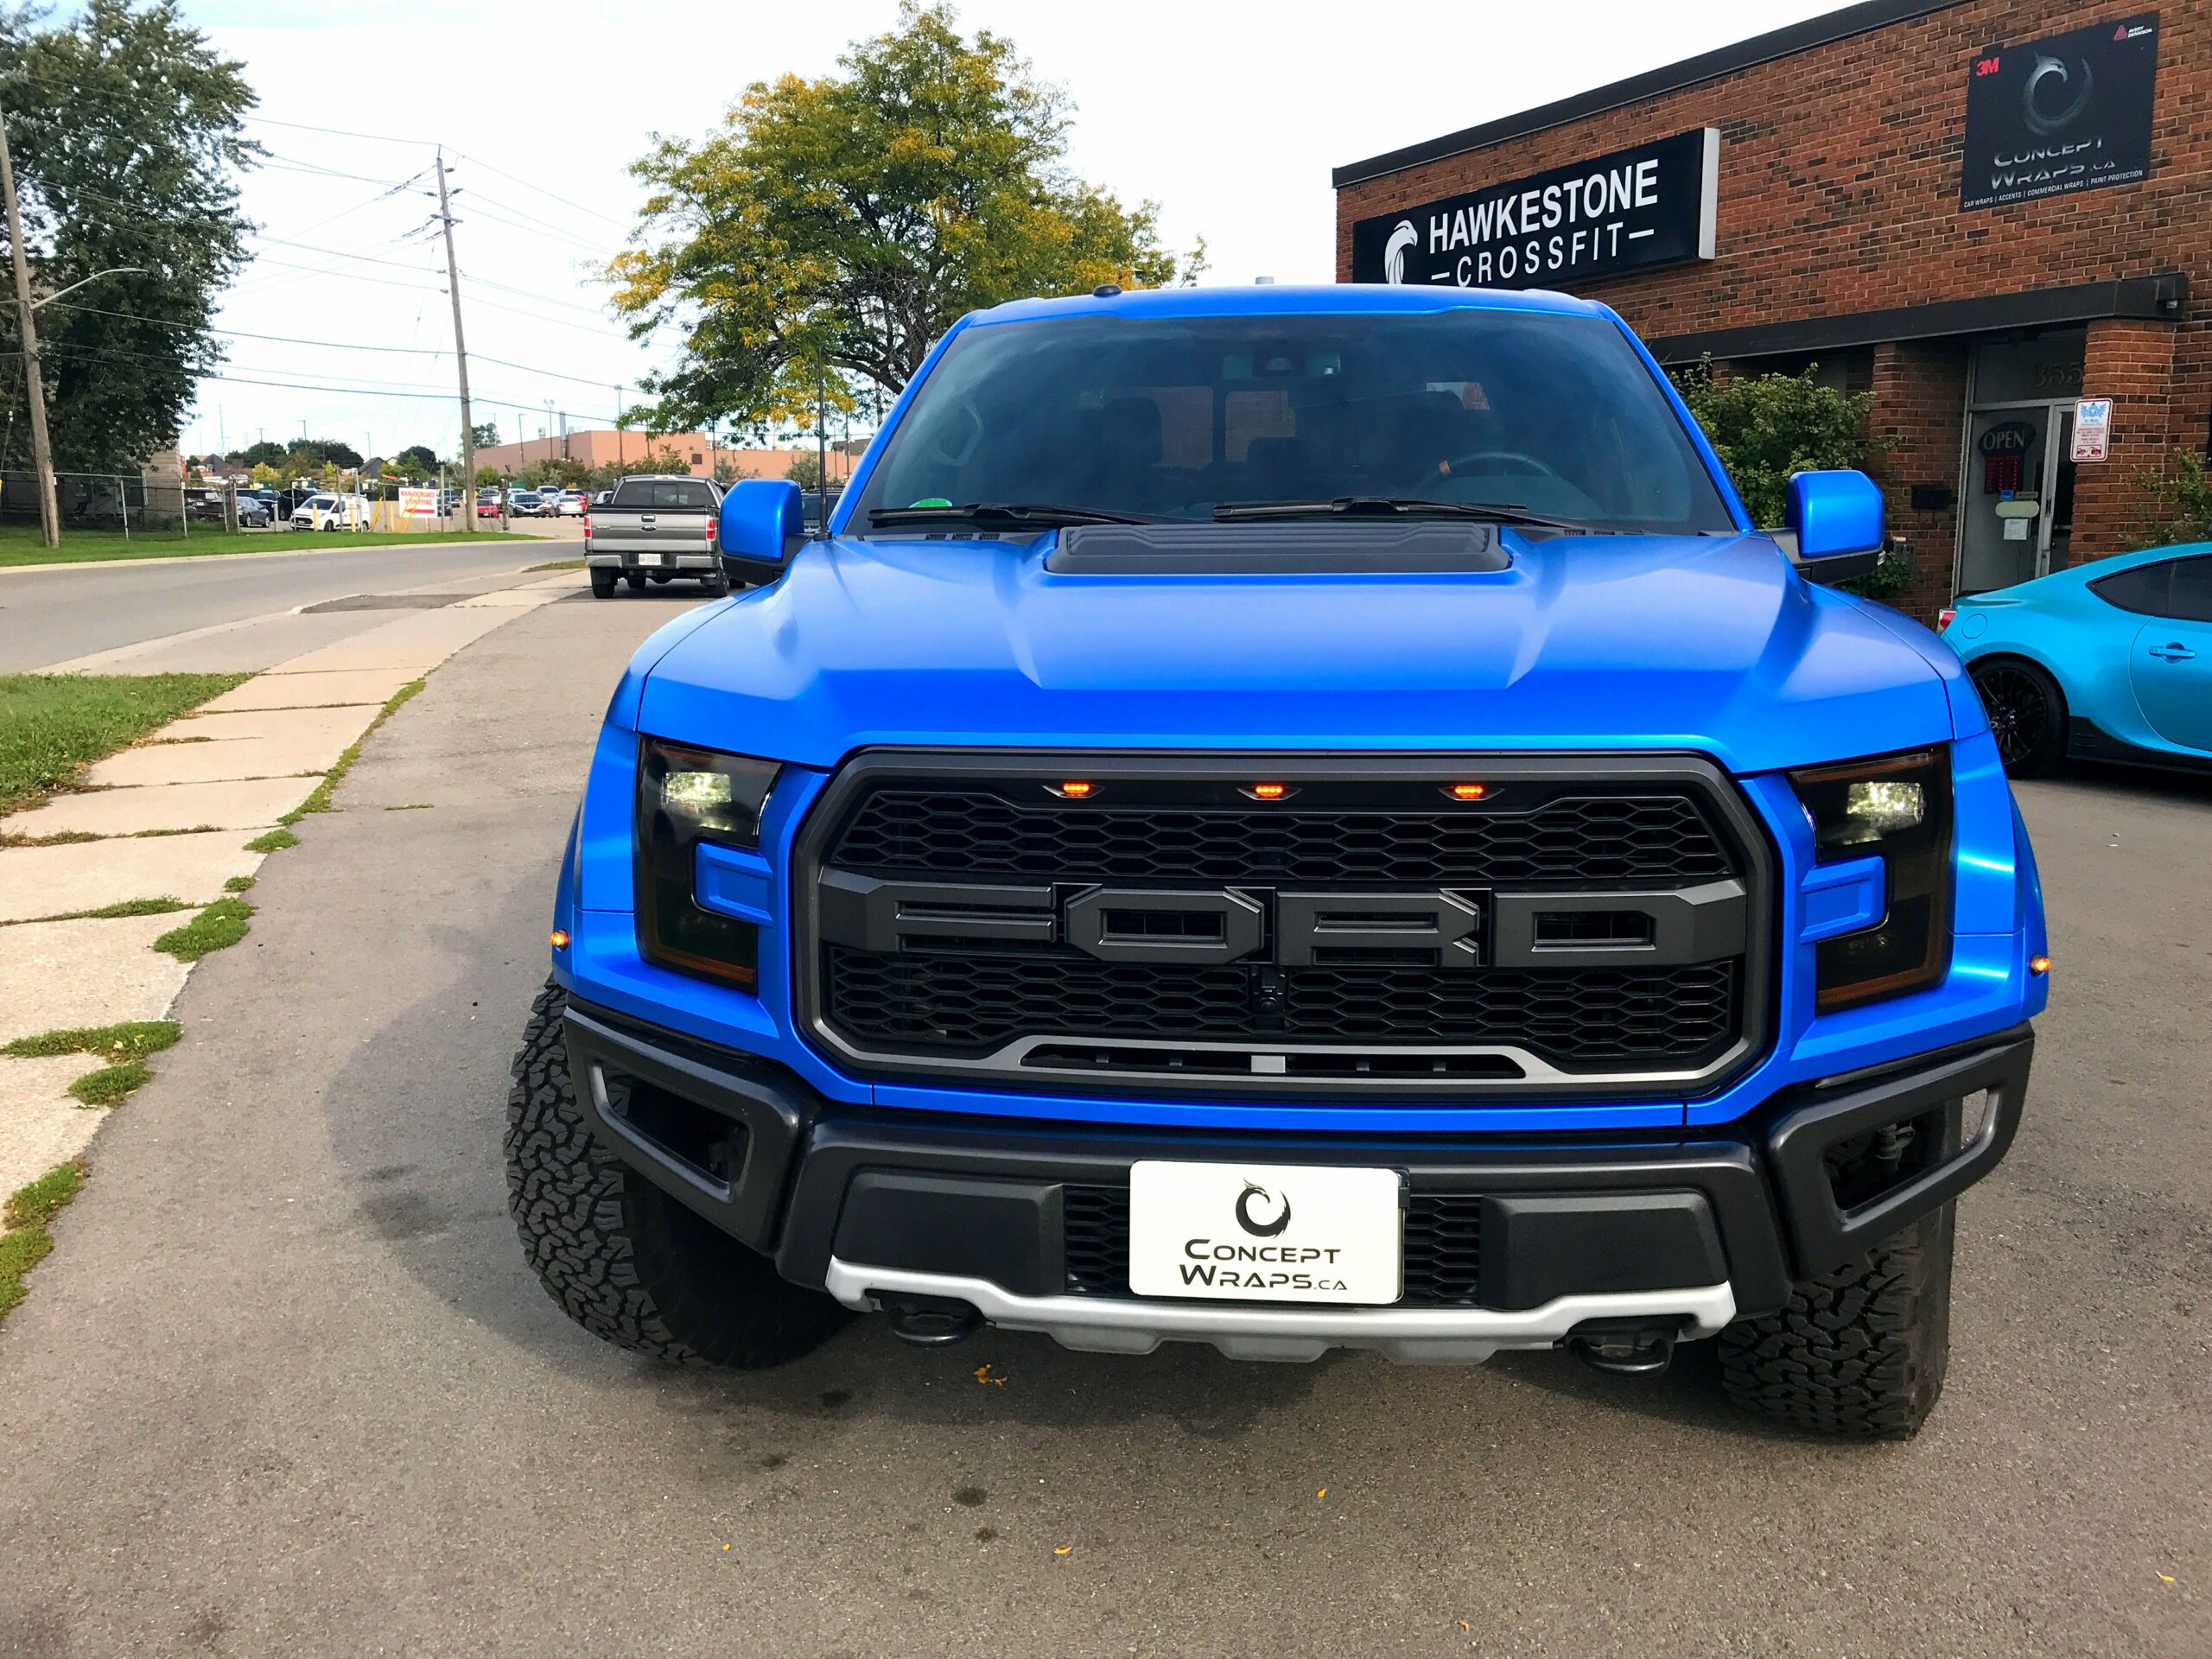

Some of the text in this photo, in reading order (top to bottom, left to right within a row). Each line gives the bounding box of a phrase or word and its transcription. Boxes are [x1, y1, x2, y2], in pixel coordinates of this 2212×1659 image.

[1976, 57, 2000, 77] 3M
[1993, 138, 2102, 167] CONCEPT
[1974, 197, 1993, 206] WRAPS
[1999, 192, 2022, 201] ACCENTS
[2027, 184, 2063, 196] COMMERCIAL
[2064, 181, 2084, 189] WRAPS
[2108, 169, 2143, 181] PROTECTION
[1430, 159, 1658, 254] HAWKESTONE
[1457, 222, 1624, 287] CROSSFIT
[1983, 429, 2025, 449] OPEN
[819, 869, 1747, 969] FORD
[1185, 1239, 1341, 1263] CONCEPT
